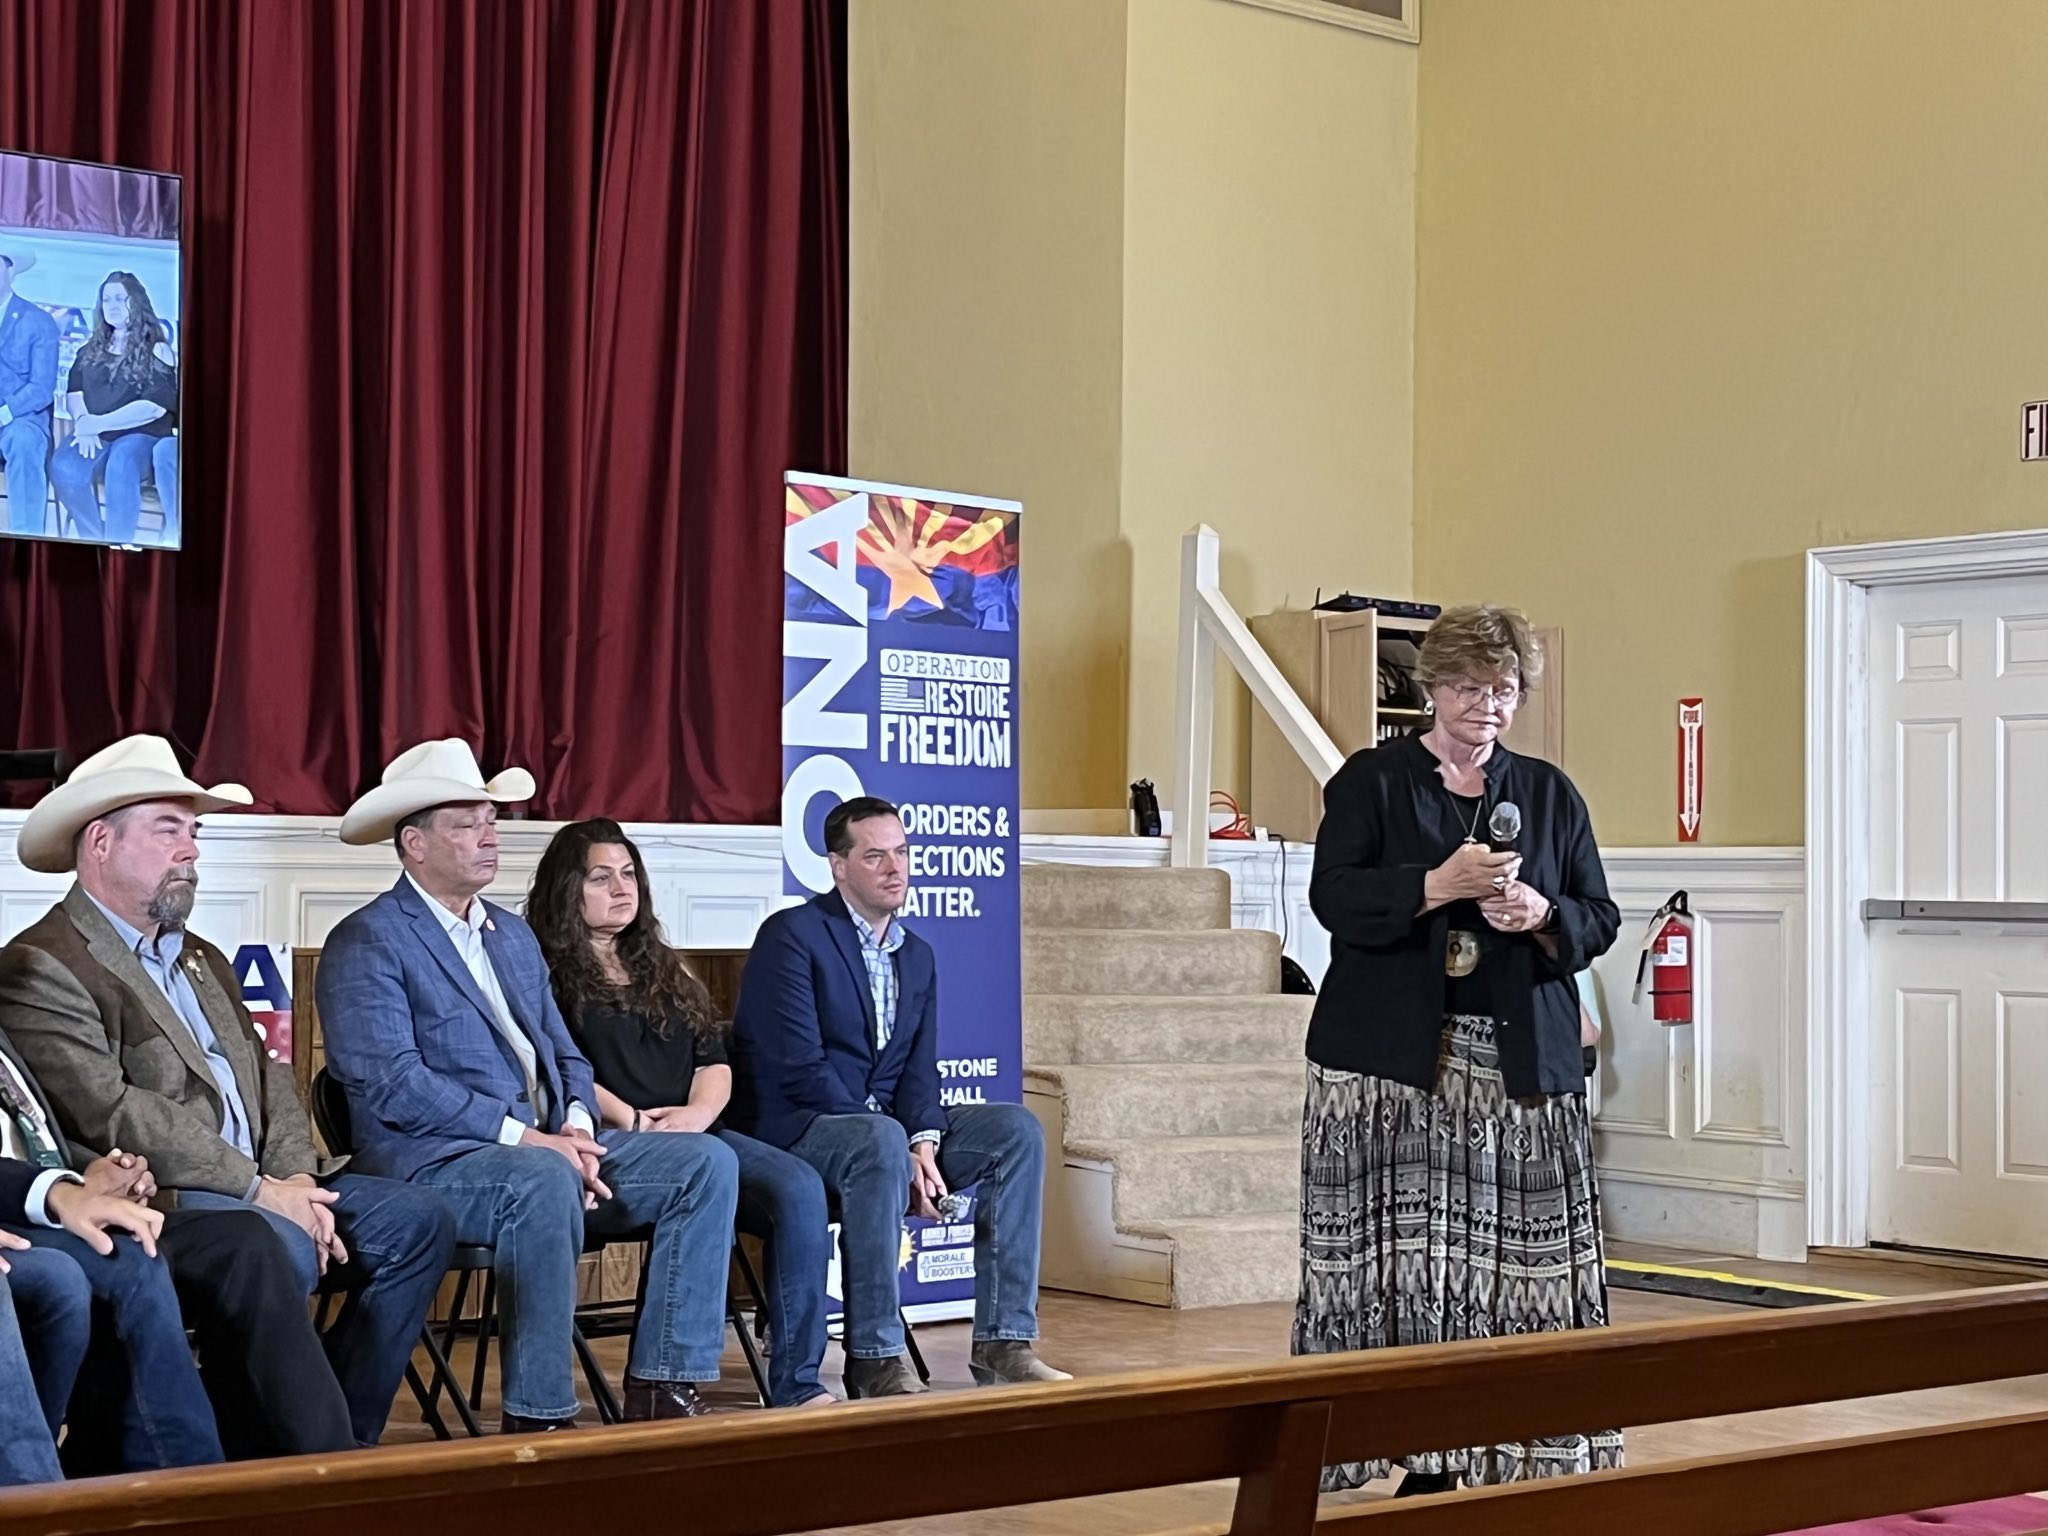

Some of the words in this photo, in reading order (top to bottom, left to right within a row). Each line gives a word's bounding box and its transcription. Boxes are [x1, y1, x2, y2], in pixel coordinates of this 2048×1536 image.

[2025, 404, 2048, 458] FI
[886, 653, 1004, 680] OPERATION
[924, 680, 1010, 718] RESTORE
[880, 713, 1011, 769] FREEDOM
[892, 803, 991, 837] ORDERS
[995, 806, 1010, 838] &
[893, 886, 981, 917] ATTER.
[936, 1057, 998, 1079] STONE
[939, 1086, 987, 1107] HALL
